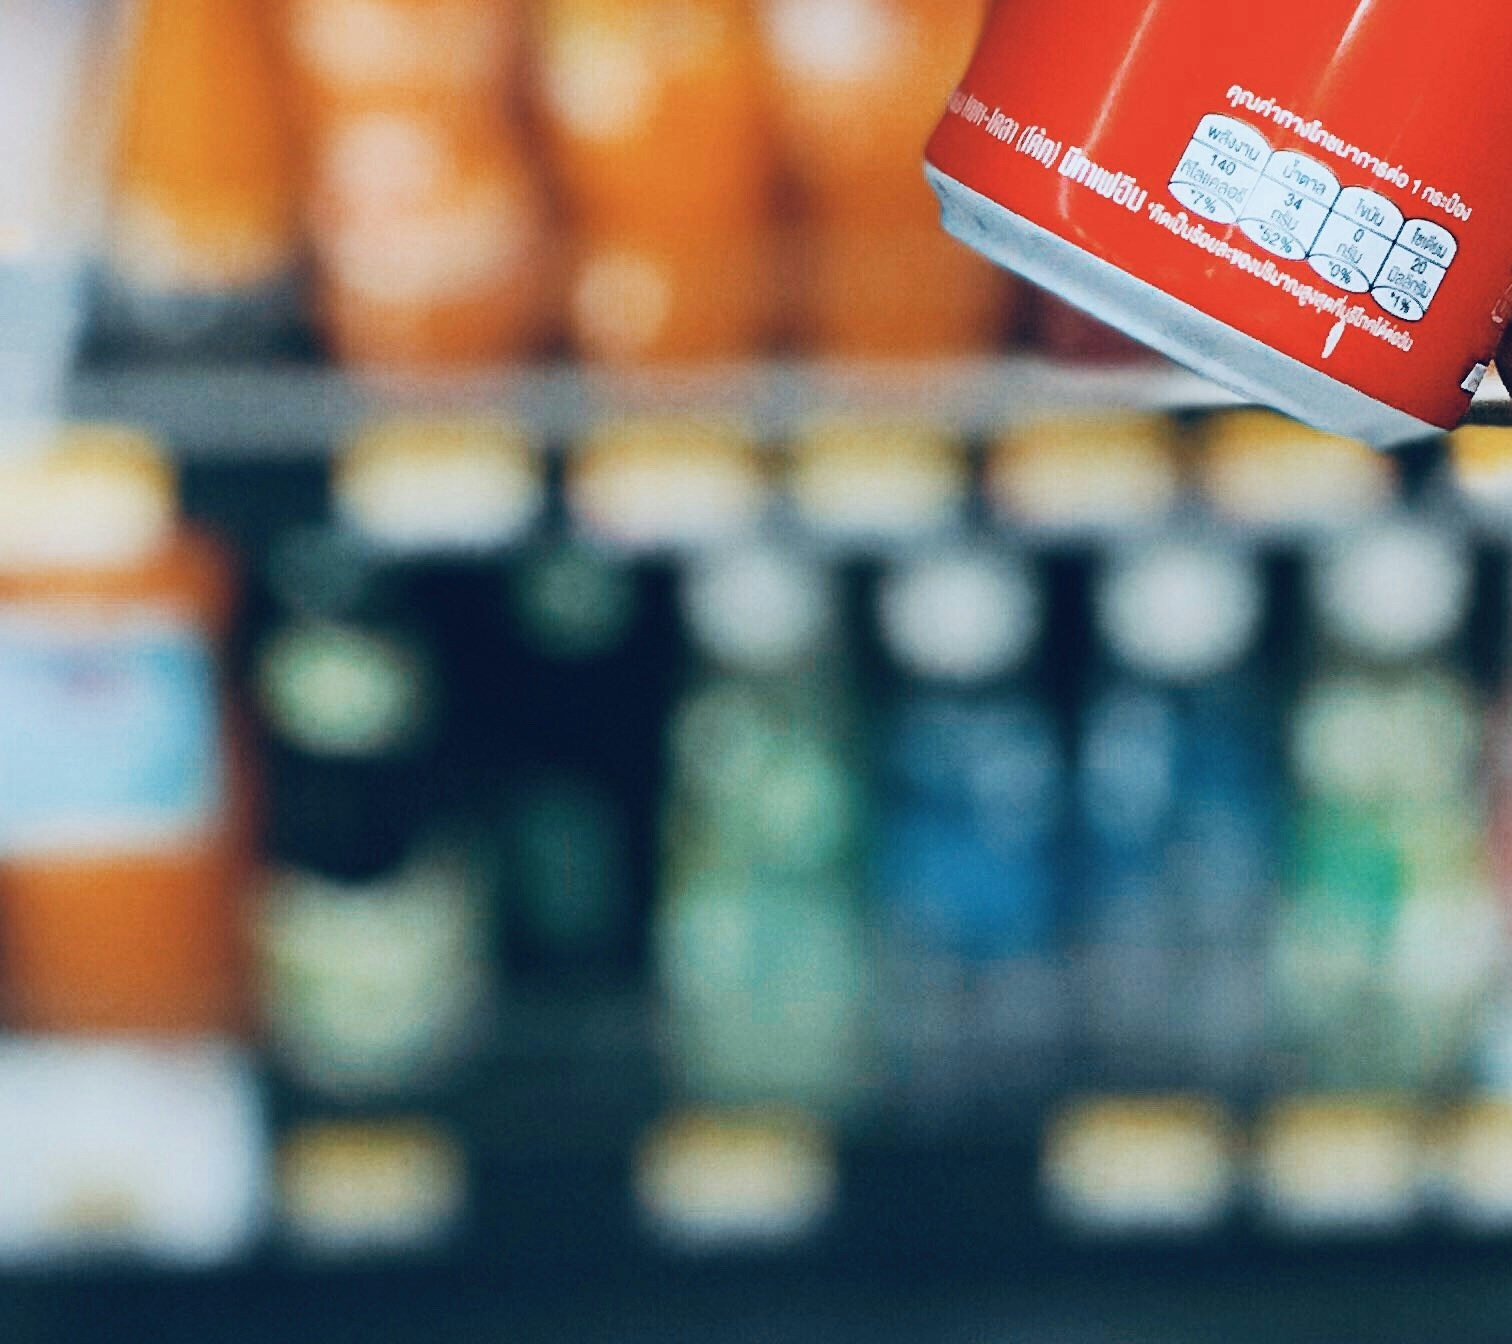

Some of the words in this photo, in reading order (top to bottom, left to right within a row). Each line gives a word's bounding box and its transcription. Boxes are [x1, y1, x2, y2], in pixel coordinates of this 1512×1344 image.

[1208, 124, 1258, 161] พลังงาน
[1211, 153, 1236, 176] 140
[1284, 192, 1302, 211] 34
[1354, 228, 1363, 243] 0
[1411, 258, 1428, 275] 20
